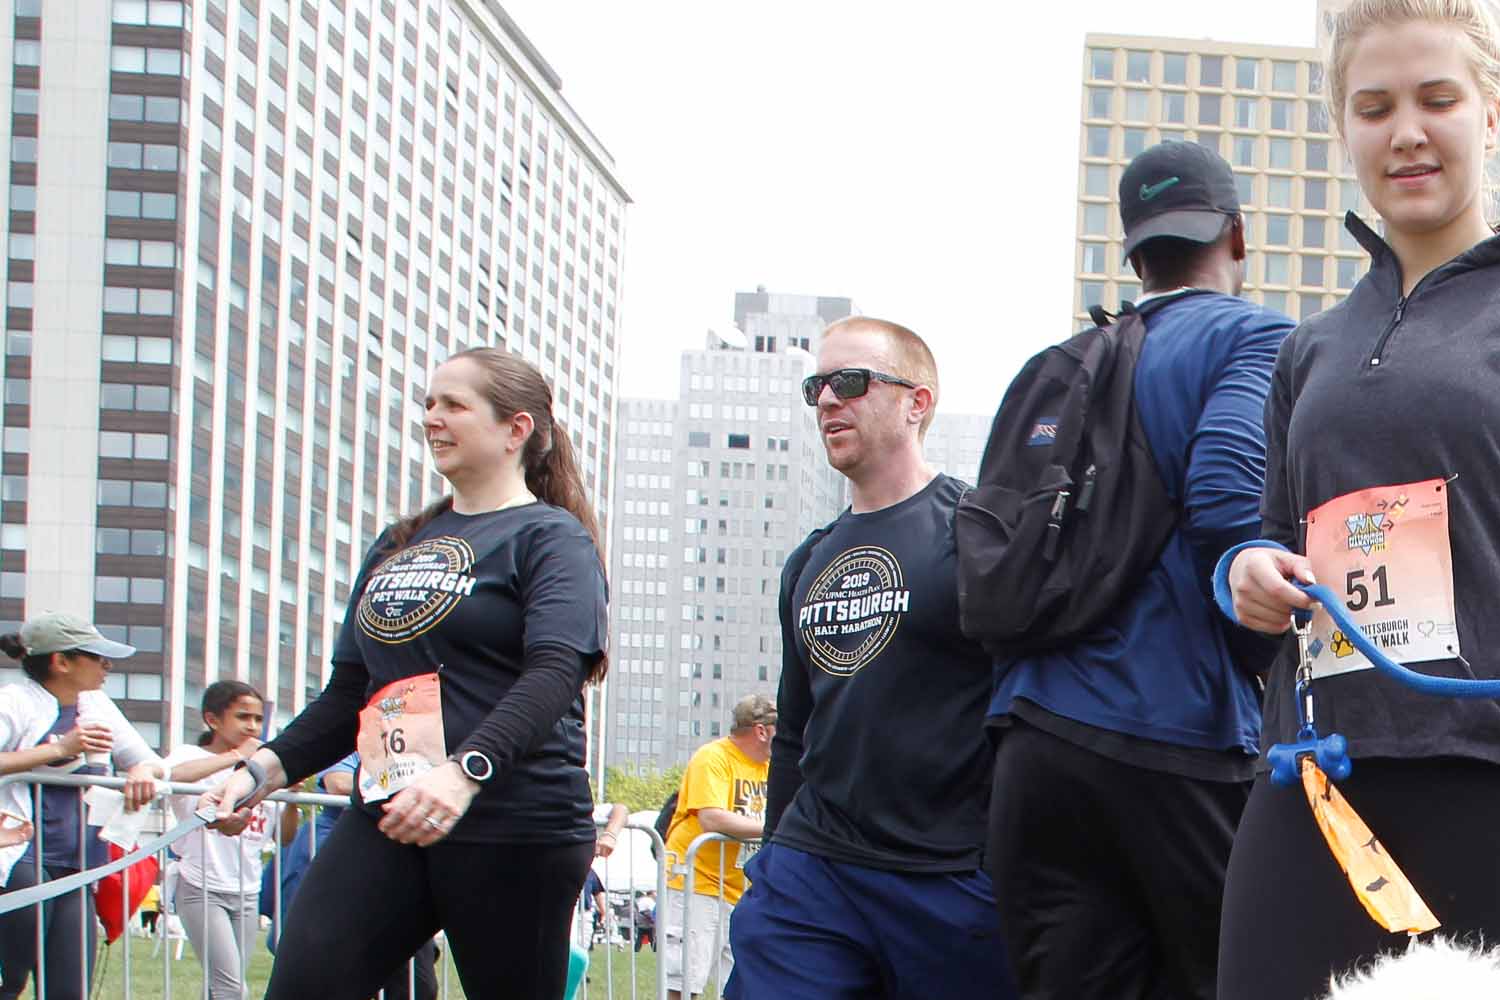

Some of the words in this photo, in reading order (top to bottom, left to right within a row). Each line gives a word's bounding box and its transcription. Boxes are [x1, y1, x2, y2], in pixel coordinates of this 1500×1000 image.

[841, 572, 871, 589] 2019
[1346, 564, 1396, 612] 51
[395, 590, 428, 601] WALK
[799, 591, 911, 629] PITTSBURGH
[814, 624, 839, 636] HALF
[841, 616, 883, 634] MARATHON
[1381, 632, 1410, 648] WALK
